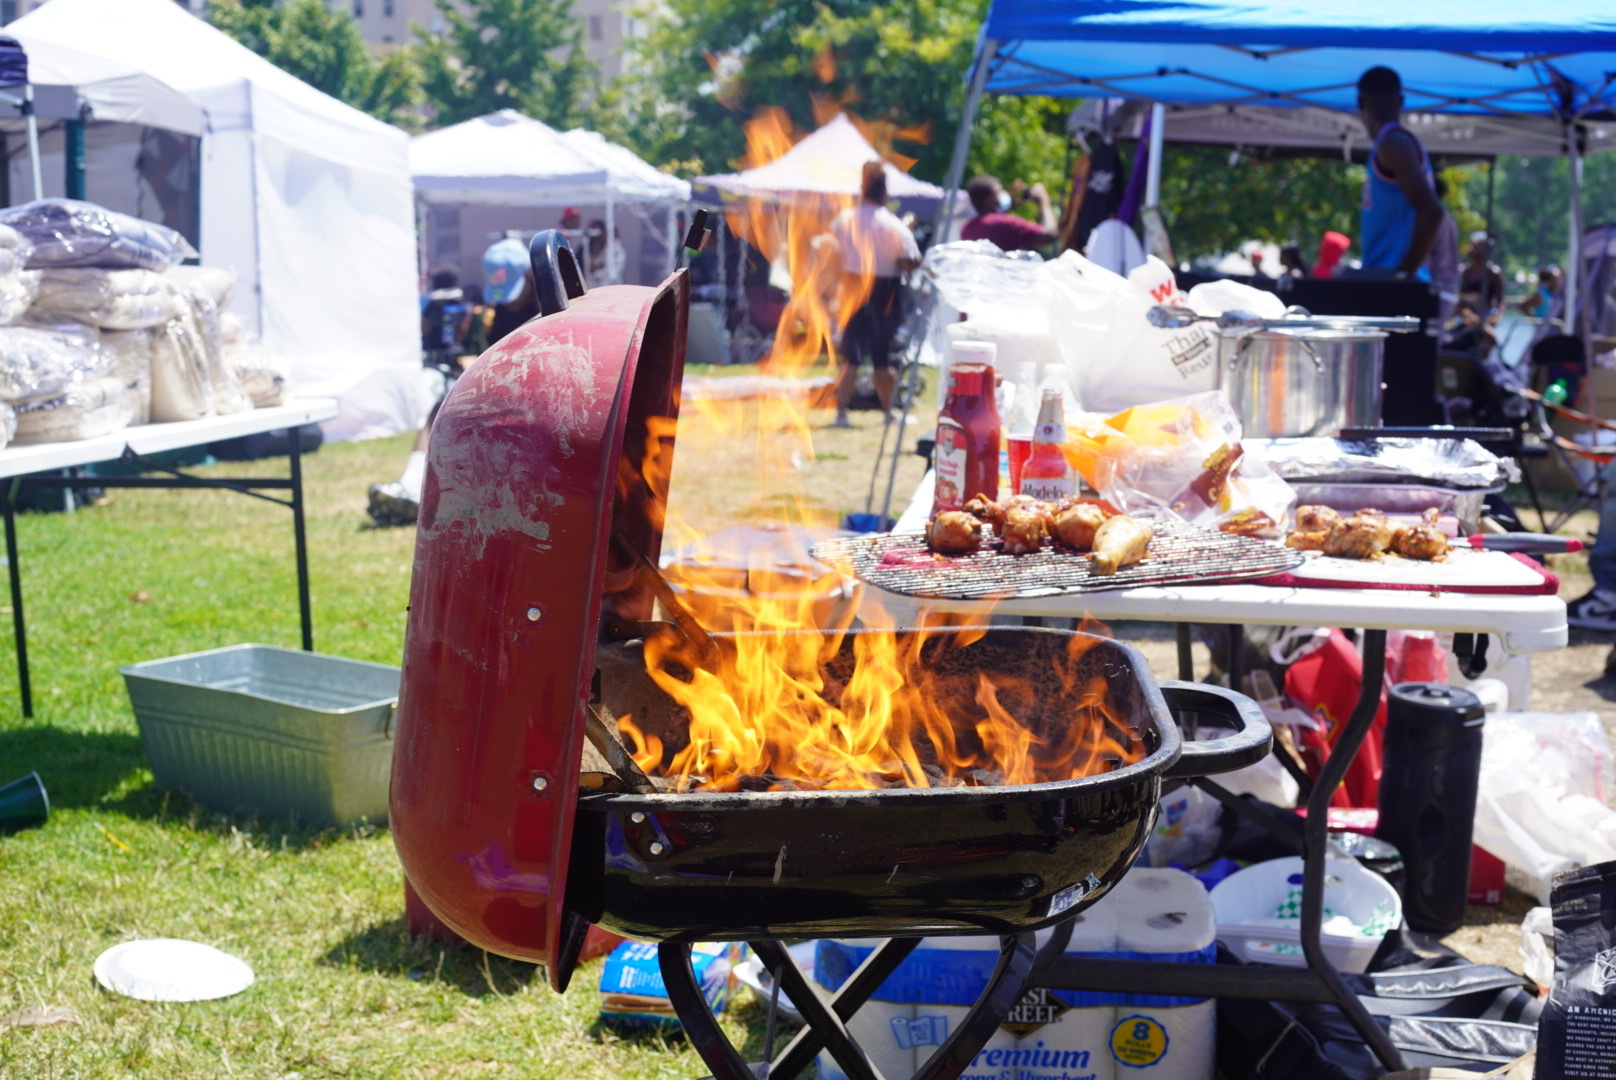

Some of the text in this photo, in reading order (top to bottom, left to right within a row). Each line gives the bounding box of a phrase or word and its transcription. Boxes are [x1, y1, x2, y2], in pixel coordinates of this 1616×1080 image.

[1008, 1004, 1058, 1022] REET
[1132, 1021, 1150, 1041] 8
[970, 1041, 1090, 1069] remium
